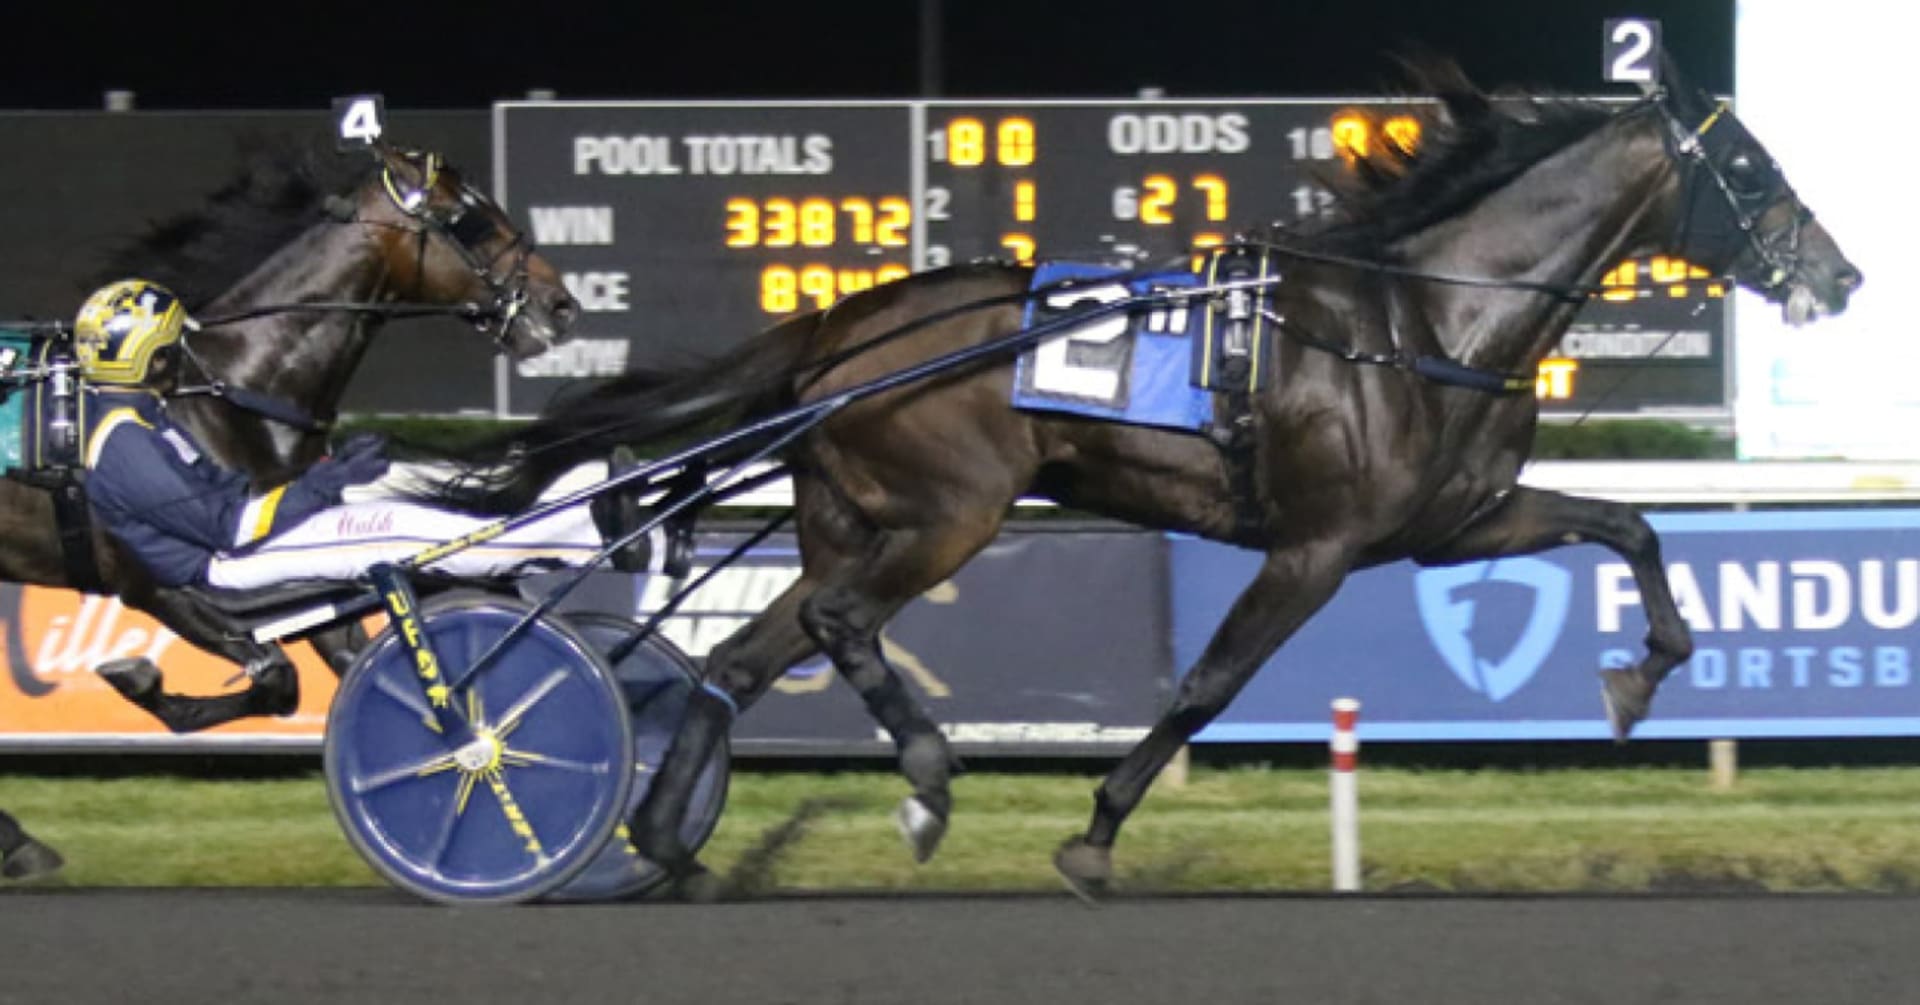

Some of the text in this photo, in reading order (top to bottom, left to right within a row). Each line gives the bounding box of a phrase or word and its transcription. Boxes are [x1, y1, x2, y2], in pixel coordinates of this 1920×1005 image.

[1611, 20, 1652, 81] 2
[341, 99, 381, 145] 4
[1108, 112, 1250, 154] ODDS
[574, 135, 833, 175] POOL TOTALS
[926, 187, 951, 221] 2
[1014, 181, 1036, 222] 1
[1112, 187, 1138, 221] 6
[1139, 172, 1229, 225] 27
[529, 206, 615, 245] WIN
[724, 196, 912, 248] 33872
[563, 272, 630, 311] ACE
[1034, 284, 1132, 401] 2
[1596, 558, 1919, 632] FANDU
[1600, 645, 1911, 688] SORTSB
